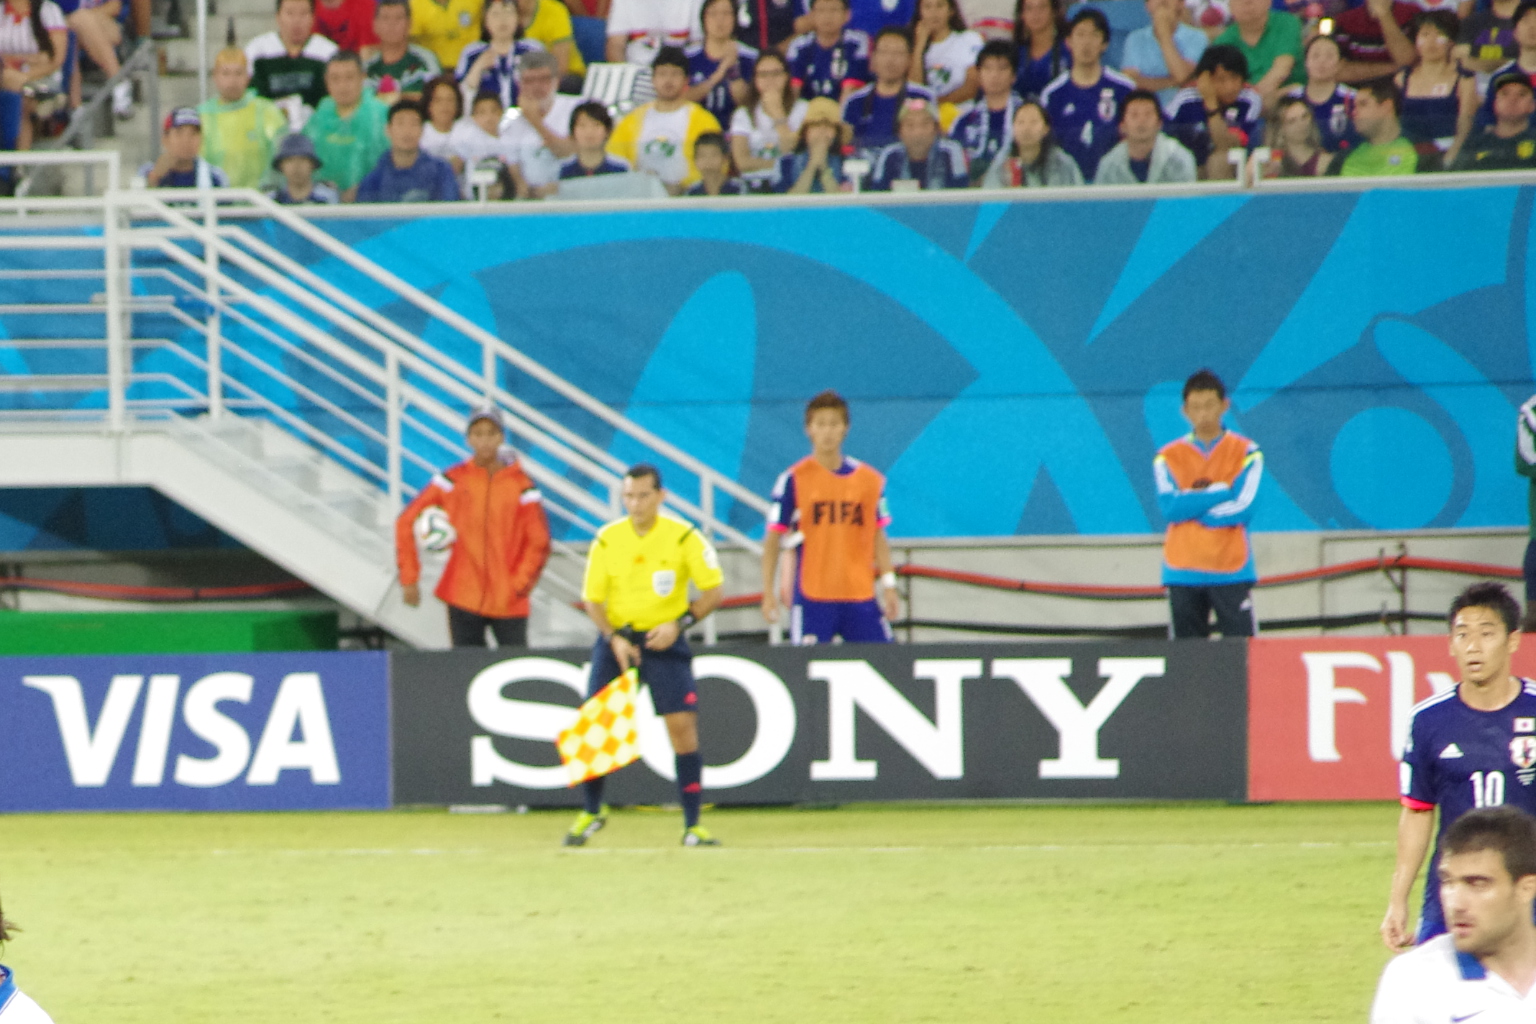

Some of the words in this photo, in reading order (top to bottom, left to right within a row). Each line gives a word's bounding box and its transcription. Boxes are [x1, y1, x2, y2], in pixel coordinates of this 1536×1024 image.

[812, 501, 864, 527] FIFA
[22, 672, 342, 787] VISA
[1469, 770, 1505, 809] 10
